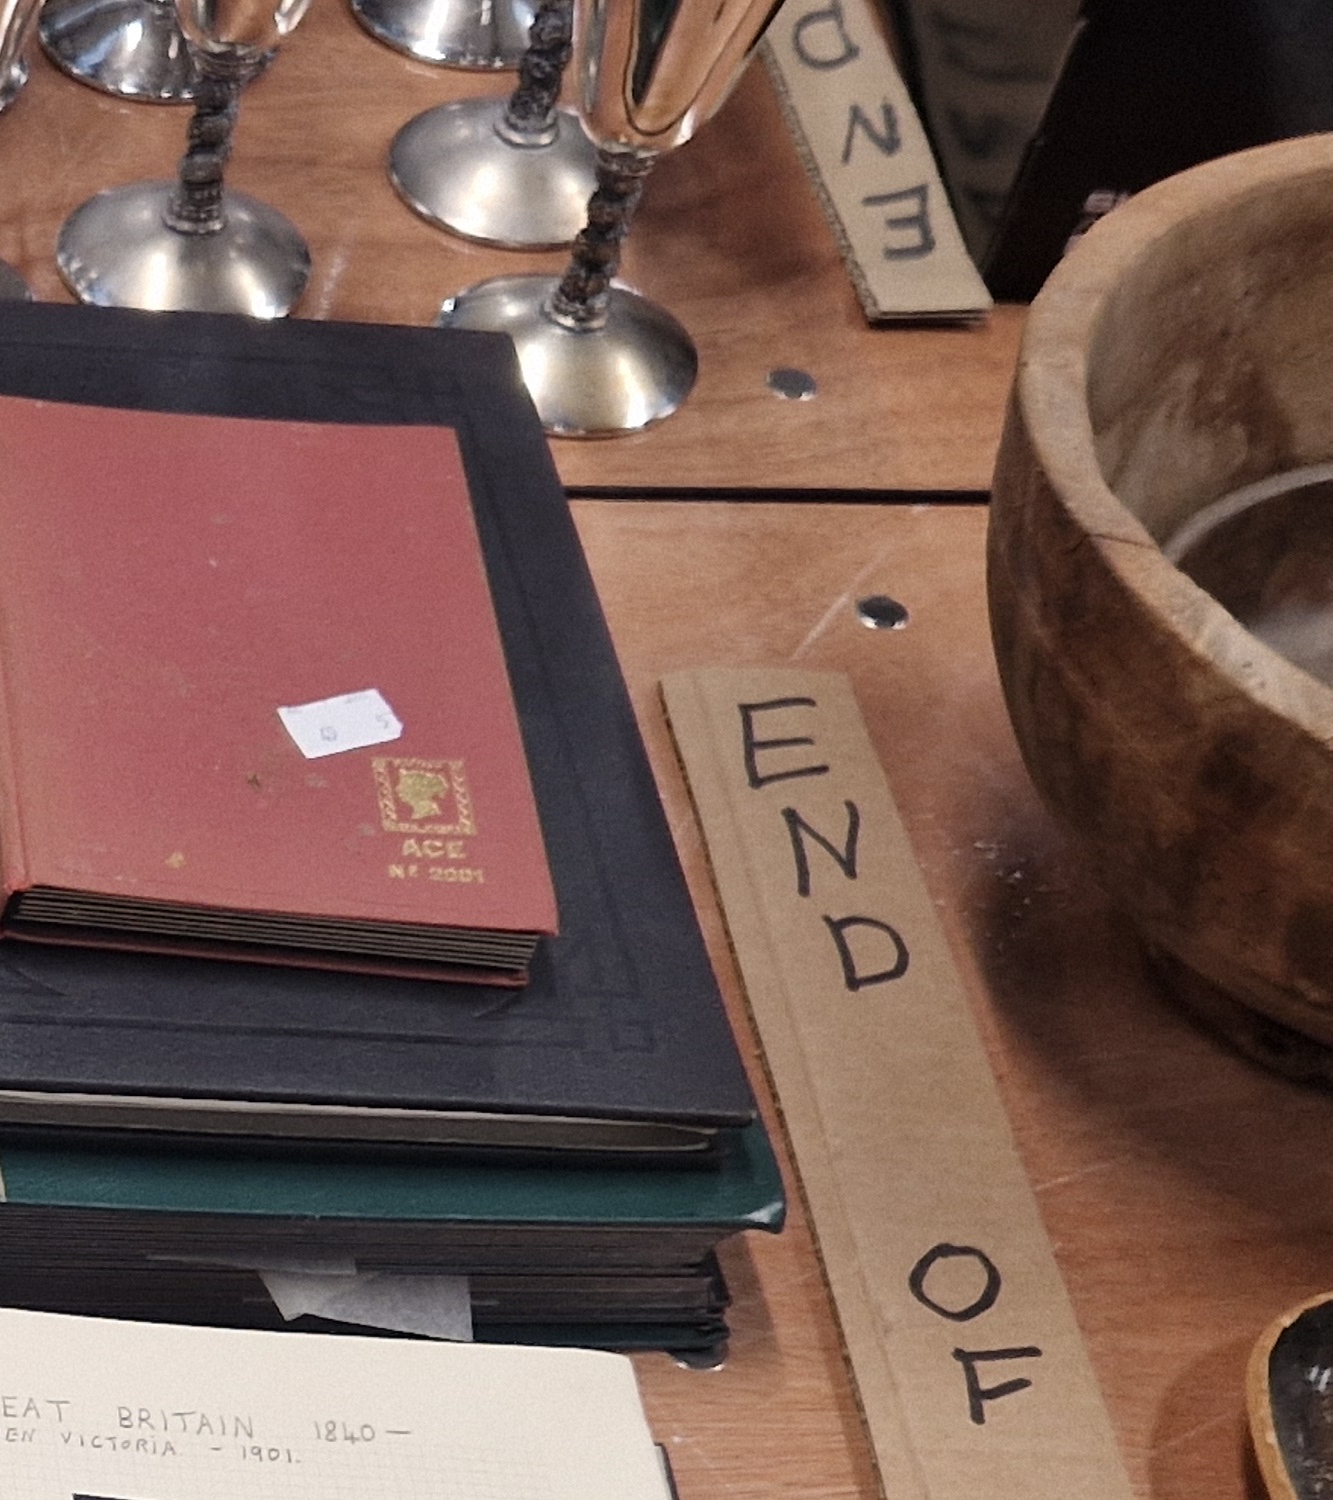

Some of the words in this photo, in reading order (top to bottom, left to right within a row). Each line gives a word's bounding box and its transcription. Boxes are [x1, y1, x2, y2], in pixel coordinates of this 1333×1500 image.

[402, 839, 466, 859] ACE
[737, 697, 910, 992] END
[908, 1243, 1043, 1425] OF
[117, 1406, 254, 1439] BRITAIN
